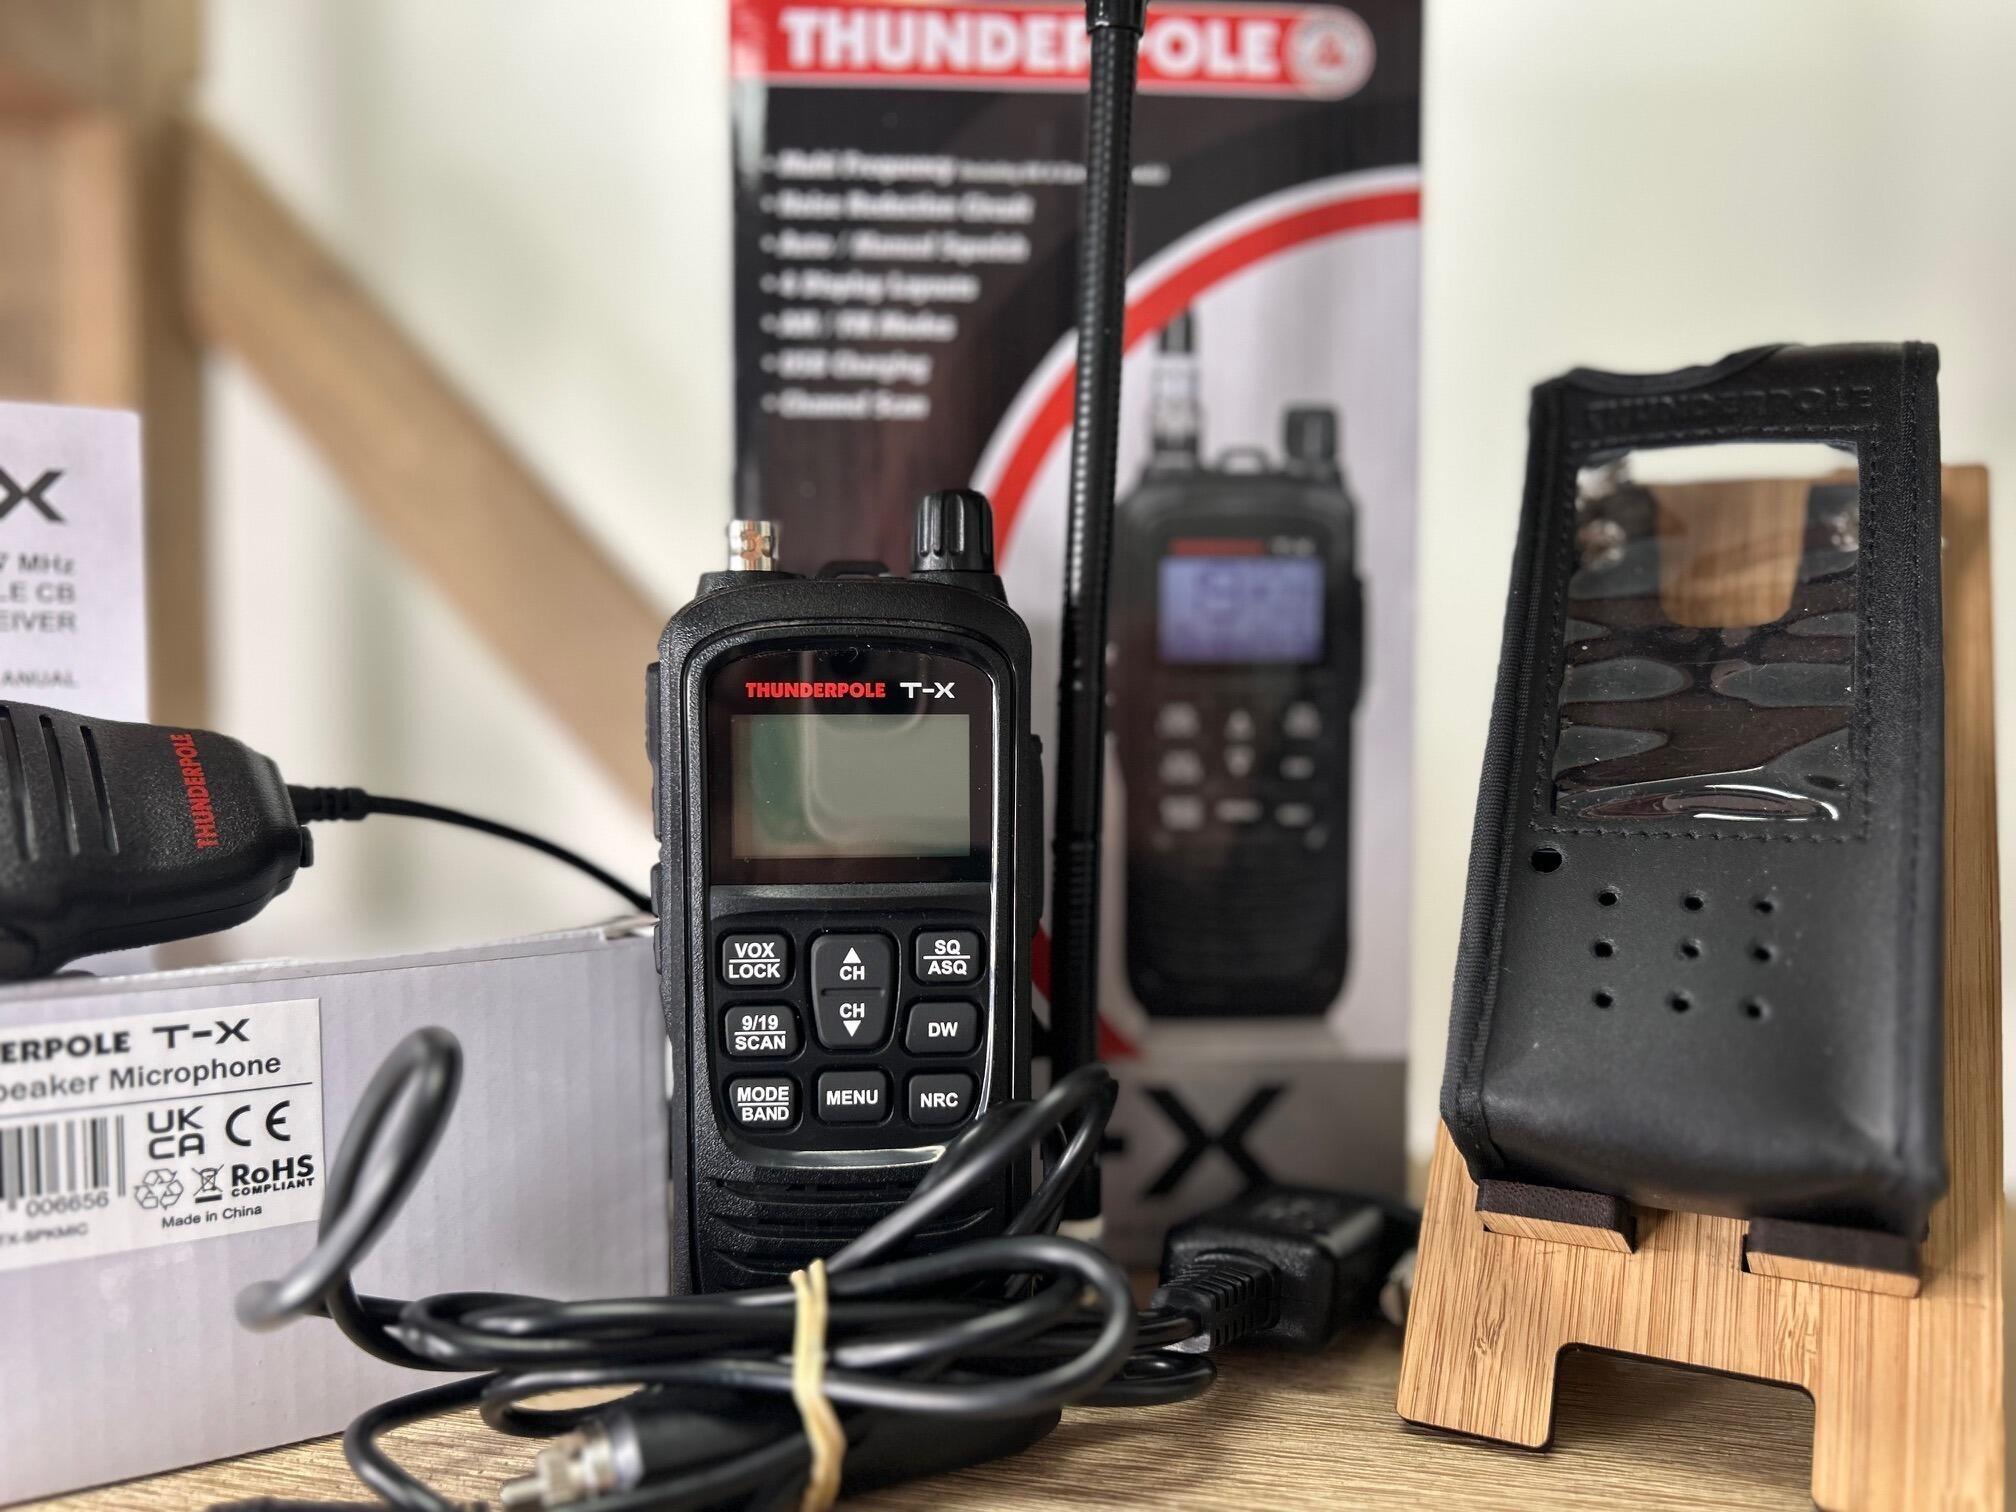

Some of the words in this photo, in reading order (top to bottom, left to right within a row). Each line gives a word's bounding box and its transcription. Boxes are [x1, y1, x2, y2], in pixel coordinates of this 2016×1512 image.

[780, 6, 1280, 78] THUNDEROLE
[745, 682, 886, 698] THUNDERPOLE
[900, 682, 955, 699] T-X
[170, 734, 220, 849] THUNDERPOLE
[735, 943, 775, 958] VOX
[935, 940, 961, 956] SQ
[729, 964, 780, 979] LOCK
[839, 966, 865, 981] CH
[928, 961, 967, 976] ASQ
[839, 1003, 865, 1018] CH
[742, 1015, 779, 1031] 9/19
[928, 1022, 958, 1037] DW
[0, 1031, 131, 1064] ERPOLE
[152, 1018, 250, 1049] T-X
[735, 1035, 786, 1051] SCAN
[110, 1056, 281, 1091] Microphone
[737, 1086, 789, 1101] MODE
[826, 1090, 878, 1105] MENU
[920, 1093, 959, 1108] NRC
[742, 1106, 789, 1122] BAND
[225, 1100, 291, 1146] CE
[231, 1154, 315, 1187] RoHS
[231, 1177, 315, 1197] COMPLIANT
[162, 1213, 201, 1229] Made
[206, 1211, 218, 1222] in
[222, 1204, 263, 1219] China
